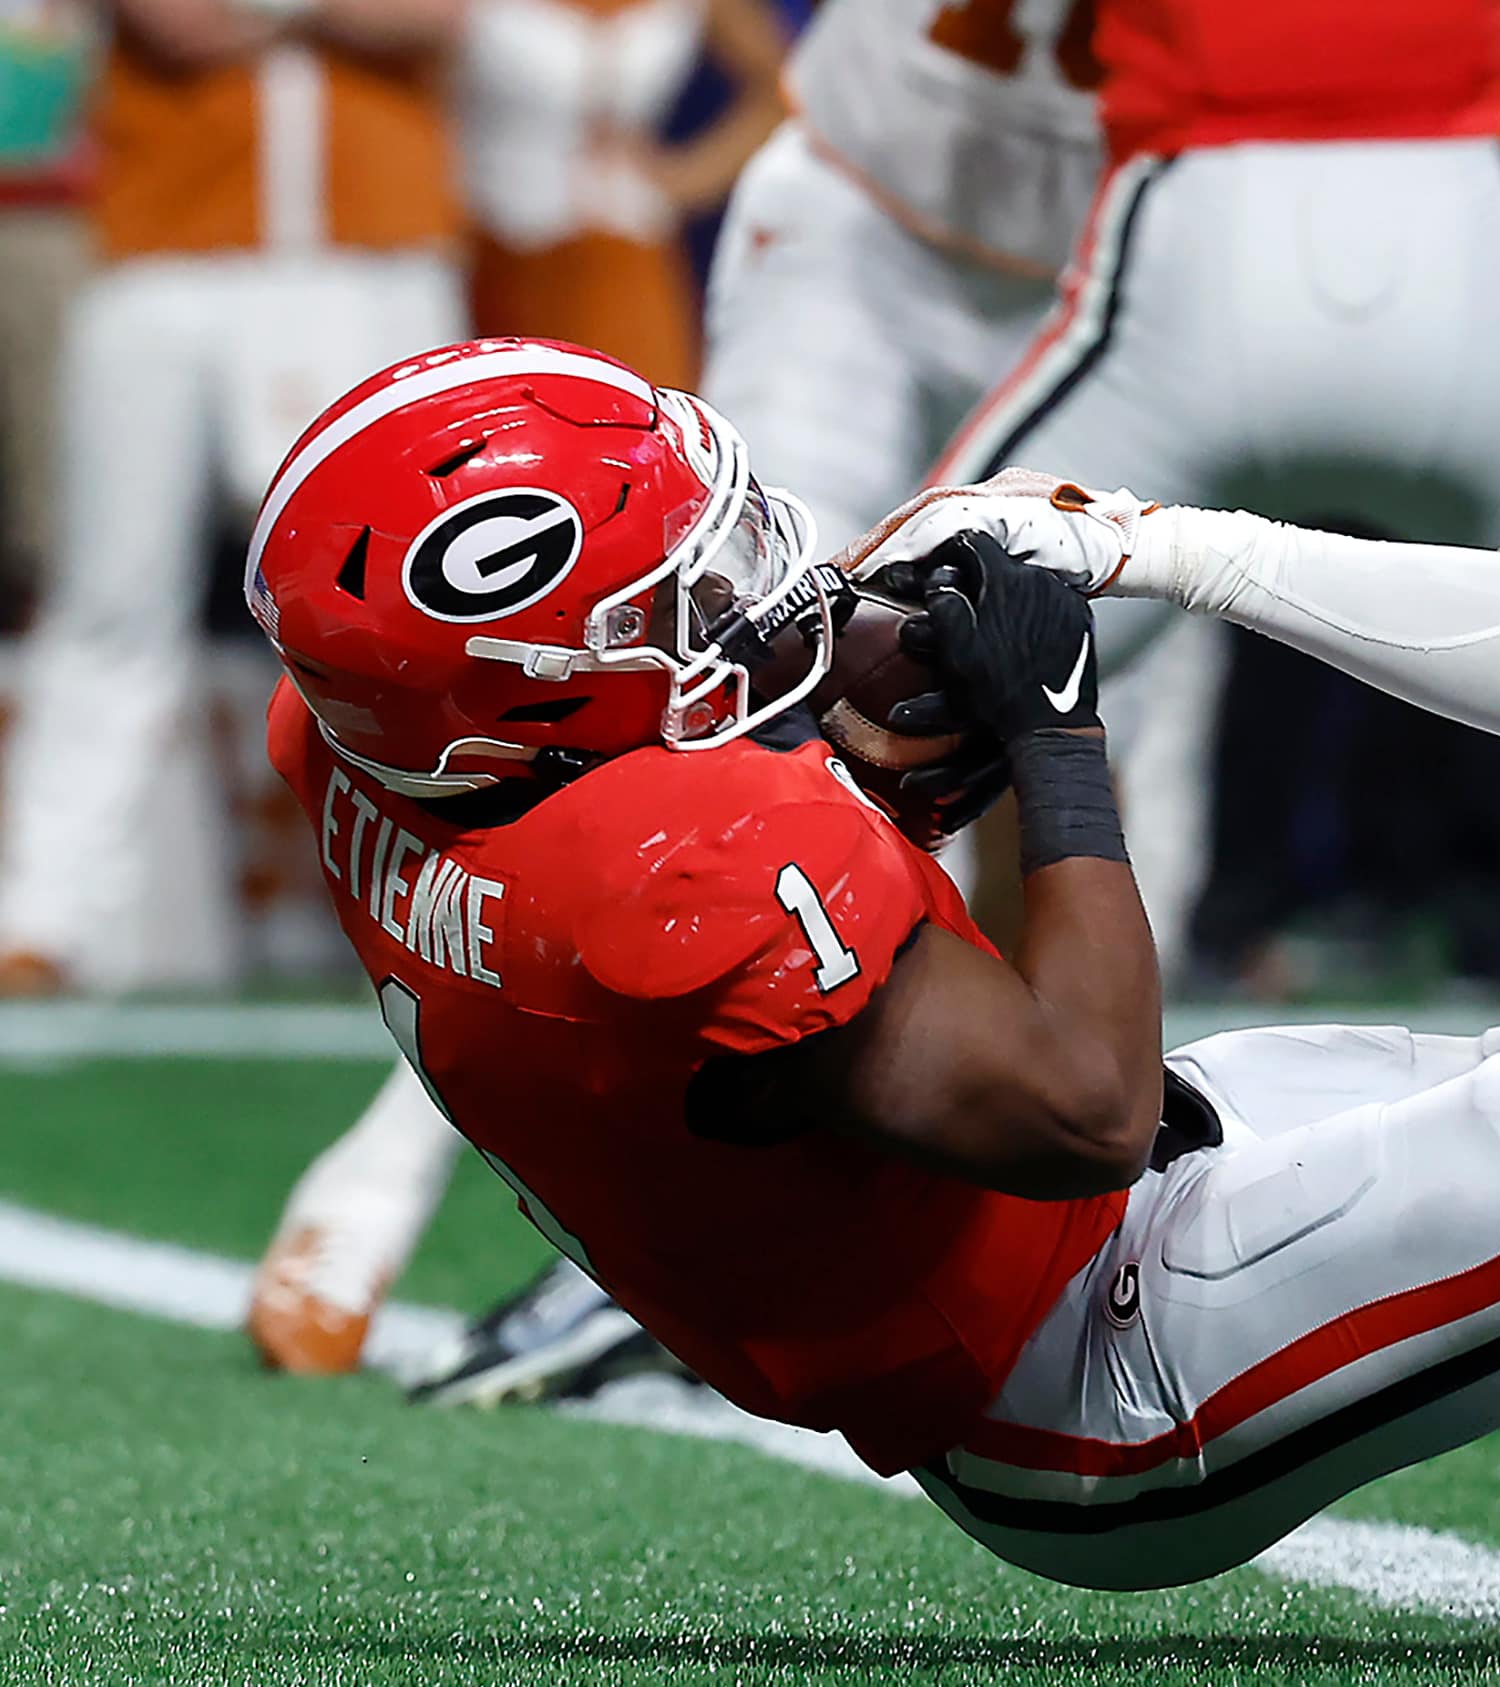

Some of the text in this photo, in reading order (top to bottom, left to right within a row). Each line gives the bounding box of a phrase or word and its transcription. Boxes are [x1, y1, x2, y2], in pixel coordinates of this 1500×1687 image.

[407, 492, 577, 617] G
[322, 766, 505, 989] ETIENNE
[774, 861, 862, 994] 1
